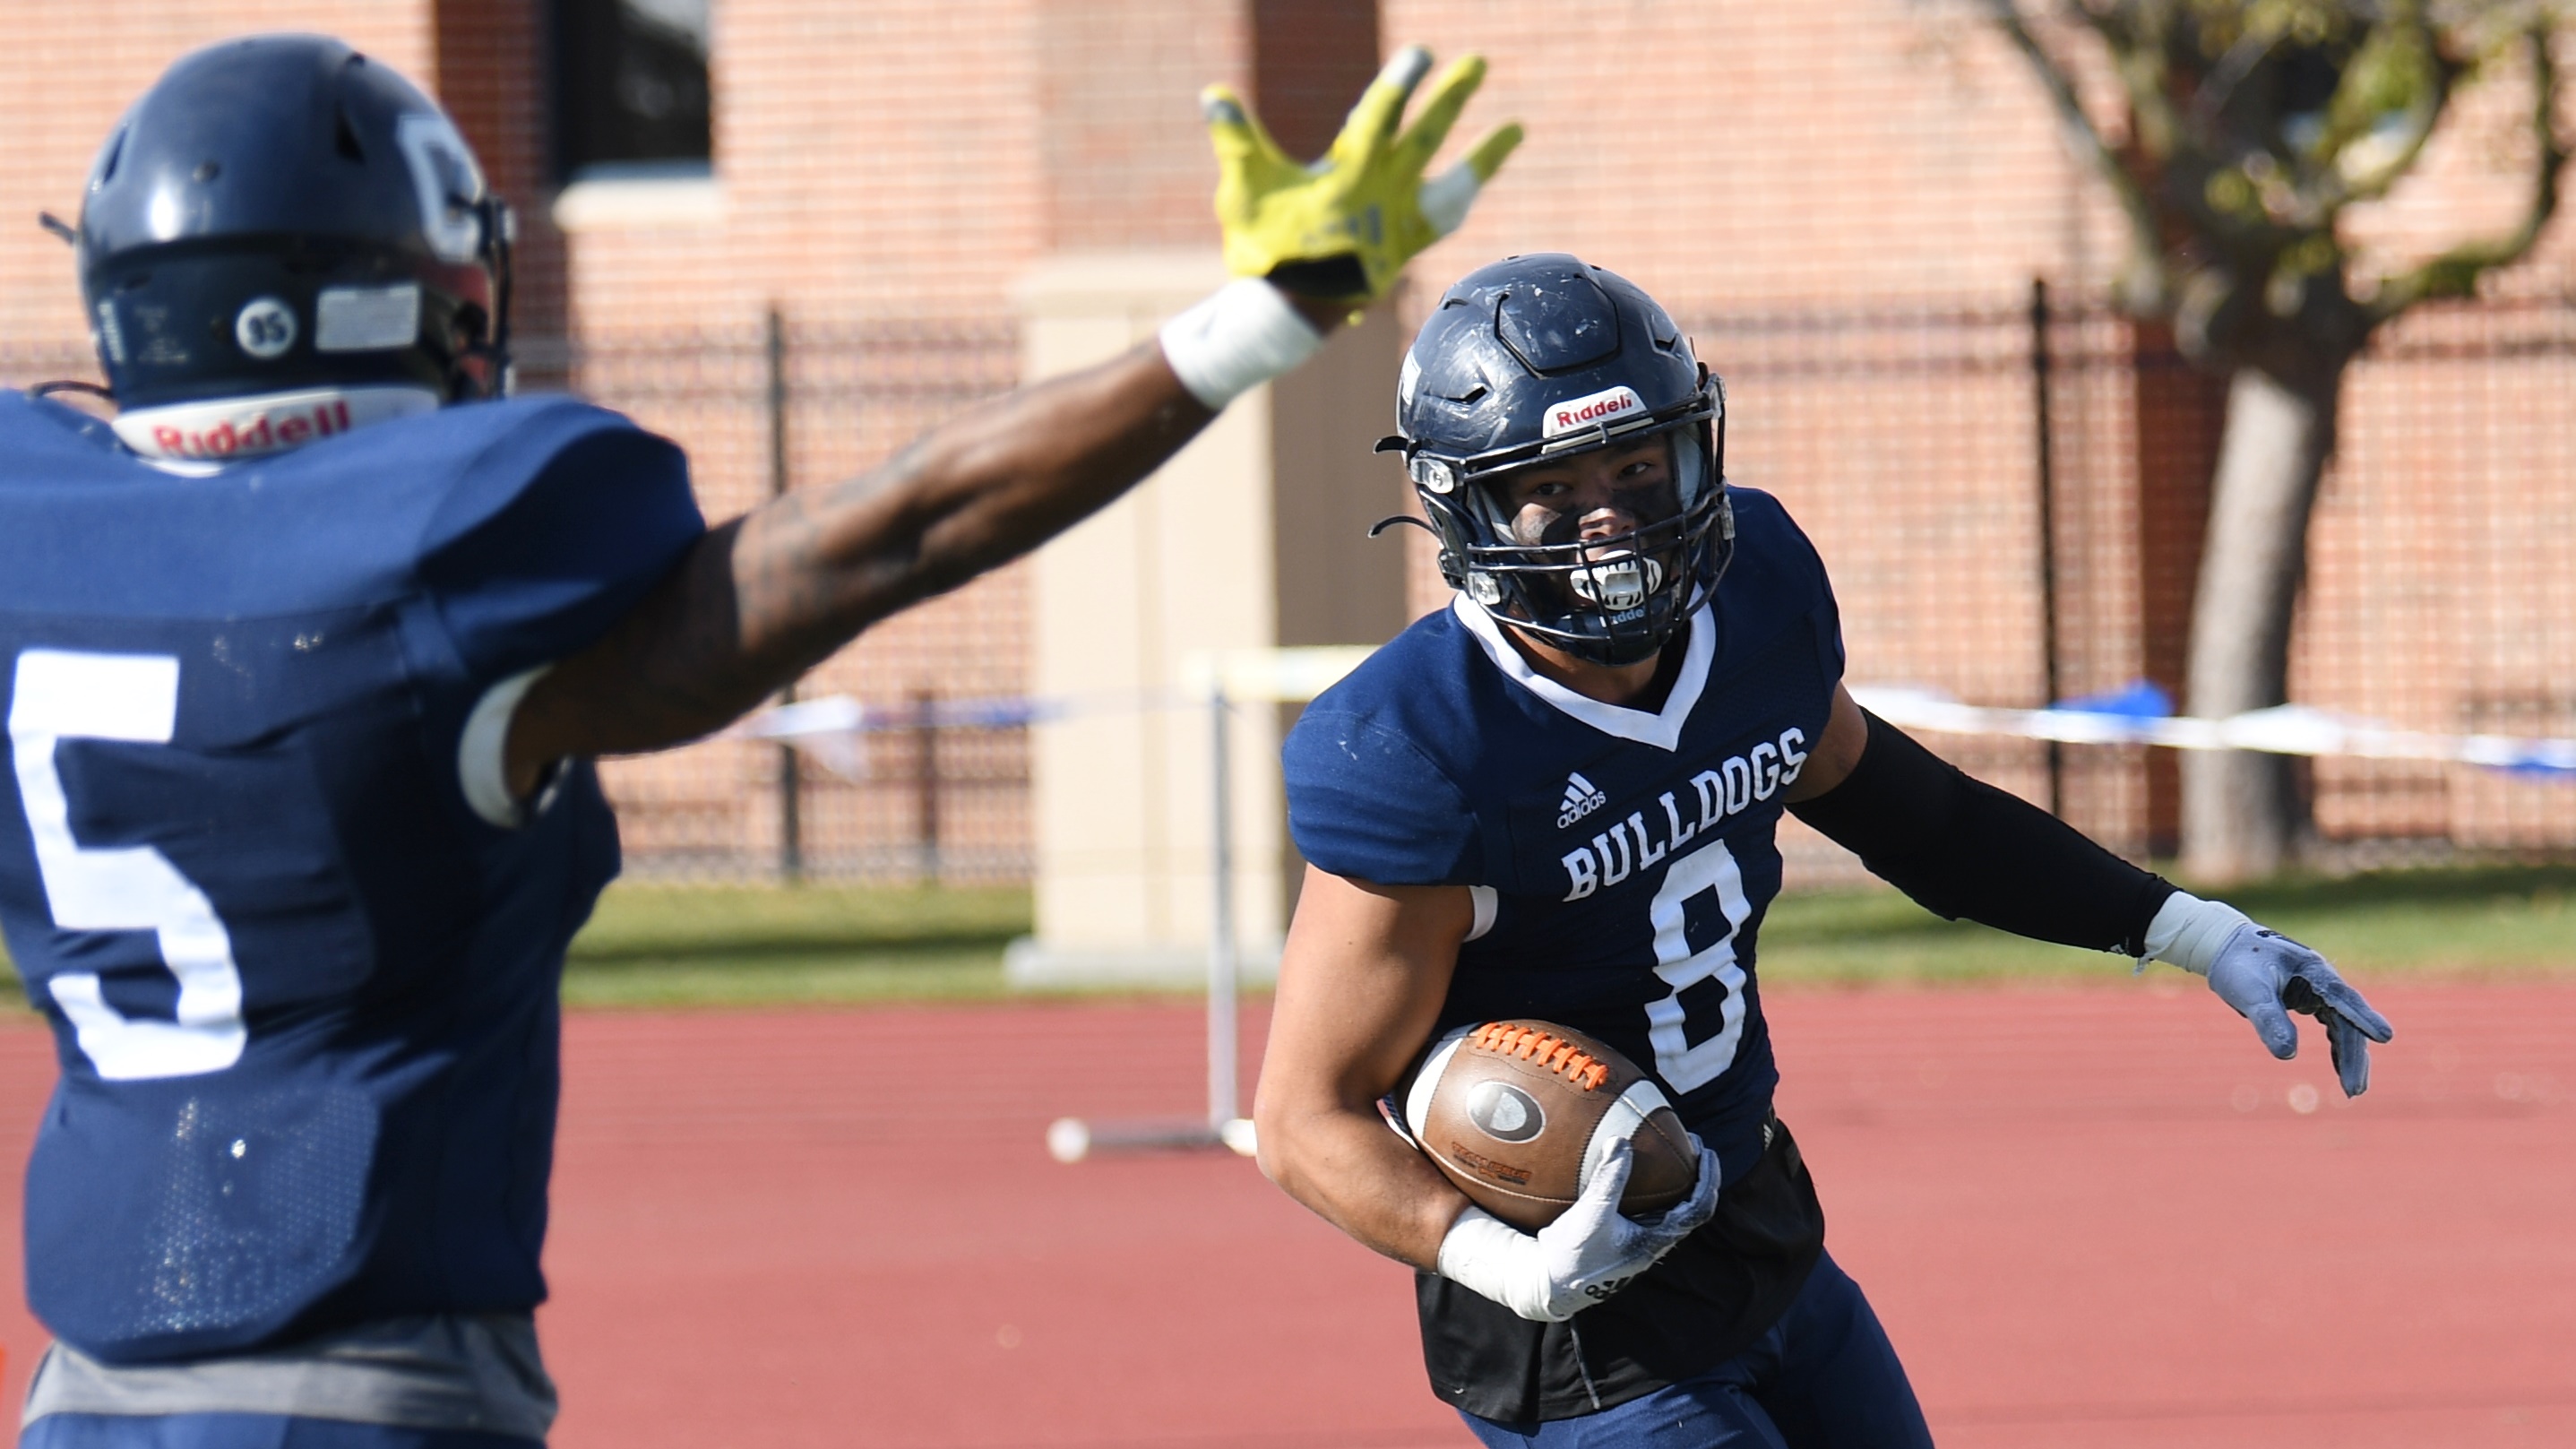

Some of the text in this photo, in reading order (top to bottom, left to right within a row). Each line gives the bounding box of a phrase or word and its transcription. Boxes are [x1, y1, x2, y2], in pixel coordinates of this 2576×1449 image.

[151, 399, 351, 456] Riddell
[8, 648, 247, 1082] 5
[1557, 789, 1607, 829] adidas
[1562, 726, 1808, 902] BULLDOGS
[1644, 838, 1752, 1095] 8
